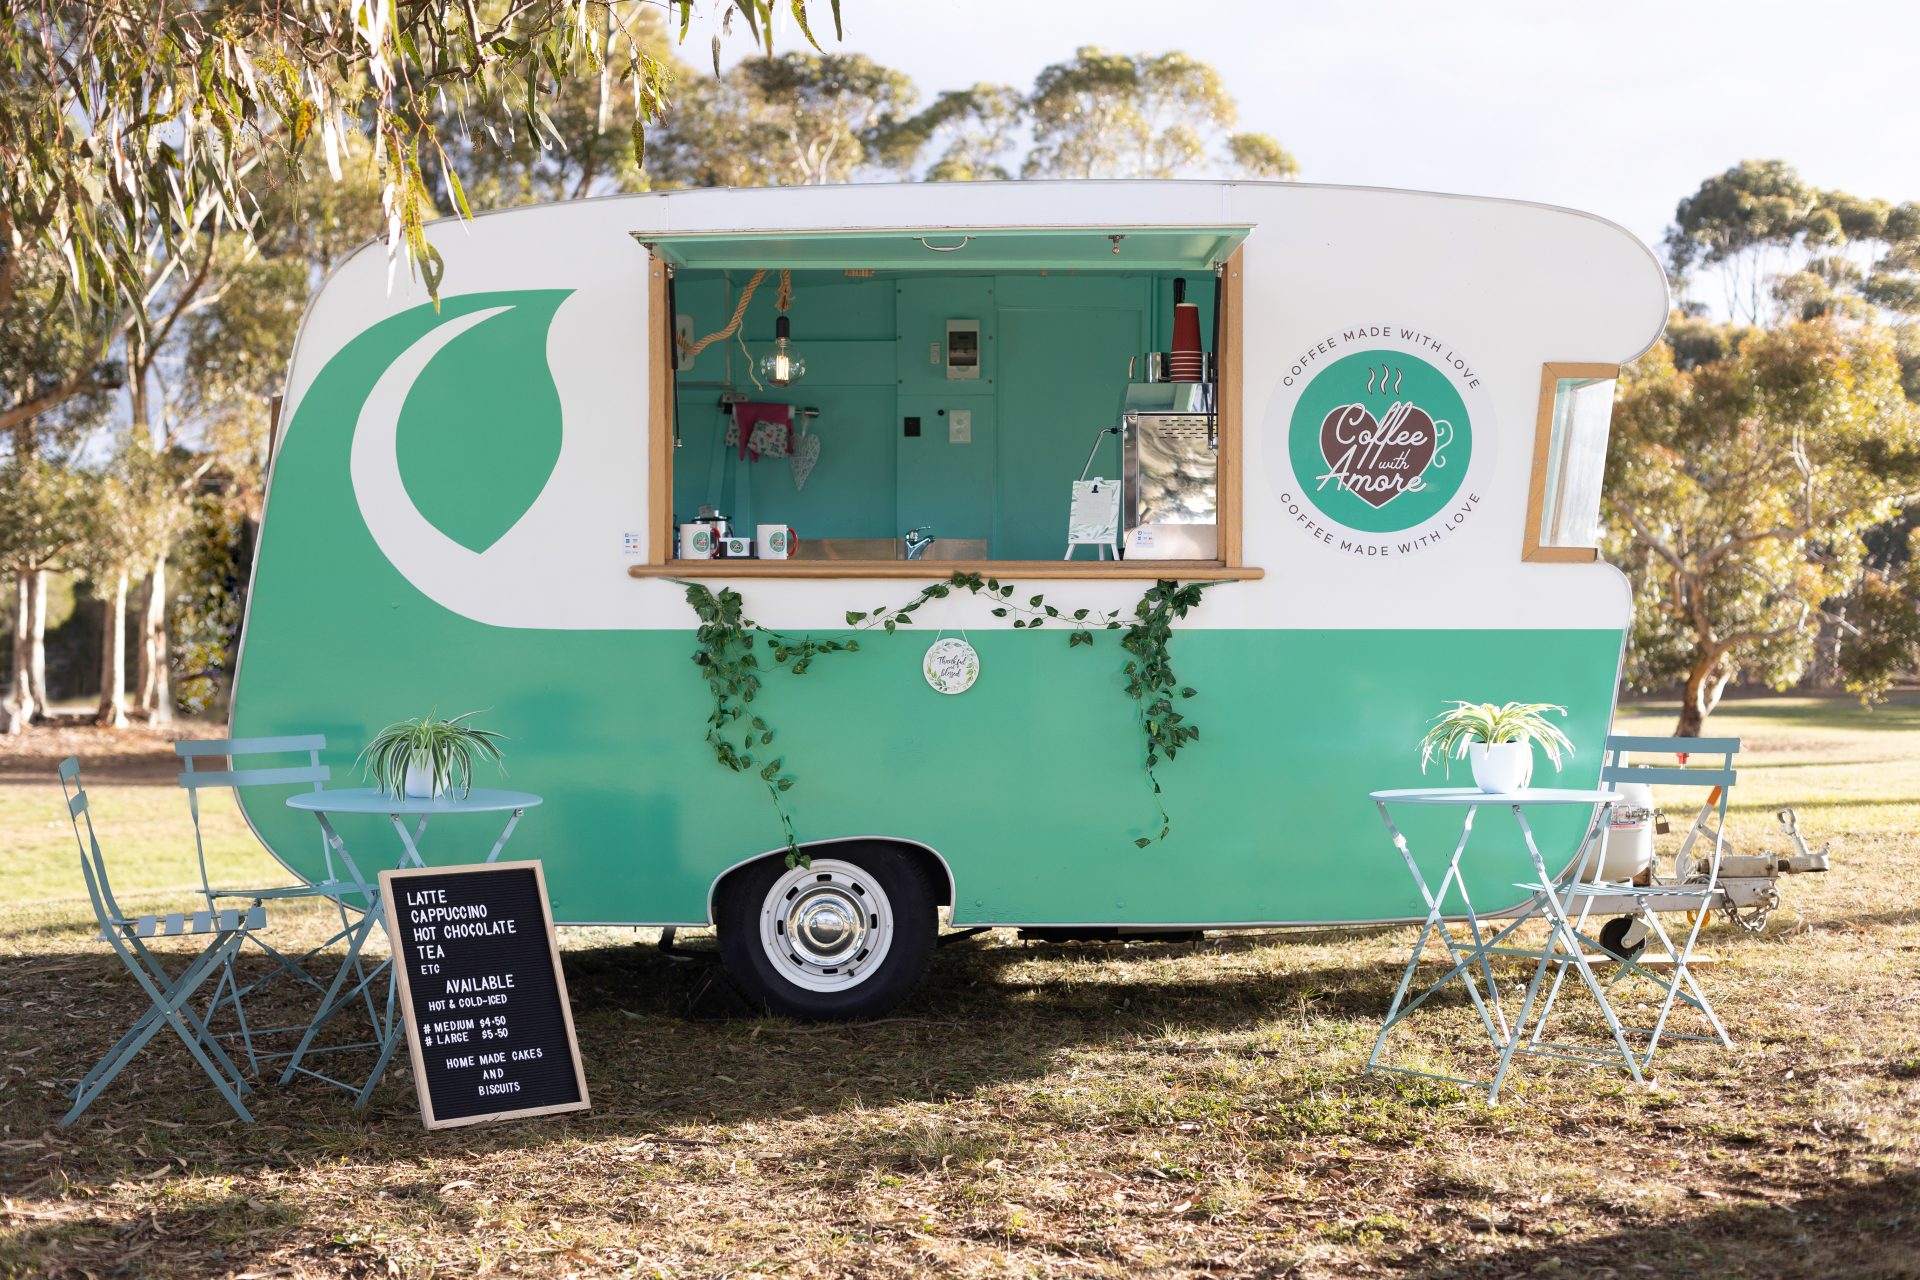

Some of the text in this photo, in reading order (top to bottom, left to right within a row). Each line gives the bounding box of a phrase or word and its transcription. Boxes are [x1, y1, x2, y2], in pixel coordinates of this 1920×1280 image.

[1283, 326, 1480, 390] COFFEE MADE WITH LOVE
[1335, 401, 1428, 469] Coffee
[1315, 444, 1427, 493] Amore
[1378, 449, 1410, 469] with
[1280, 492, 1480, 556] COFFEE MADE WITH LOVE
[406, 889, 448, 906] LATTE
[410, 904, 488, 924] CAPPUCCINO
[413, 926, 437, 942] HOT
[416, 944, 445, 960] TEA
[420, 963, 440, 975] ETC
[446, 973, 515, 994] AVAILABLE
[428, 993, 508, 1012] HOT & COLD-ICED
[423, 1023, 431, 1035] #
[433, 1018, 475, 1033] MEDIUM
[424, 1035, 433, 1047] #
[436, 1031, 469, 1045] LARGE
[445, 1047, 543, 1070] HOME MADE CAKES
[483, 1068, 504, 1080] AND
[478, 1081, 521, 1096] BISCUITS
